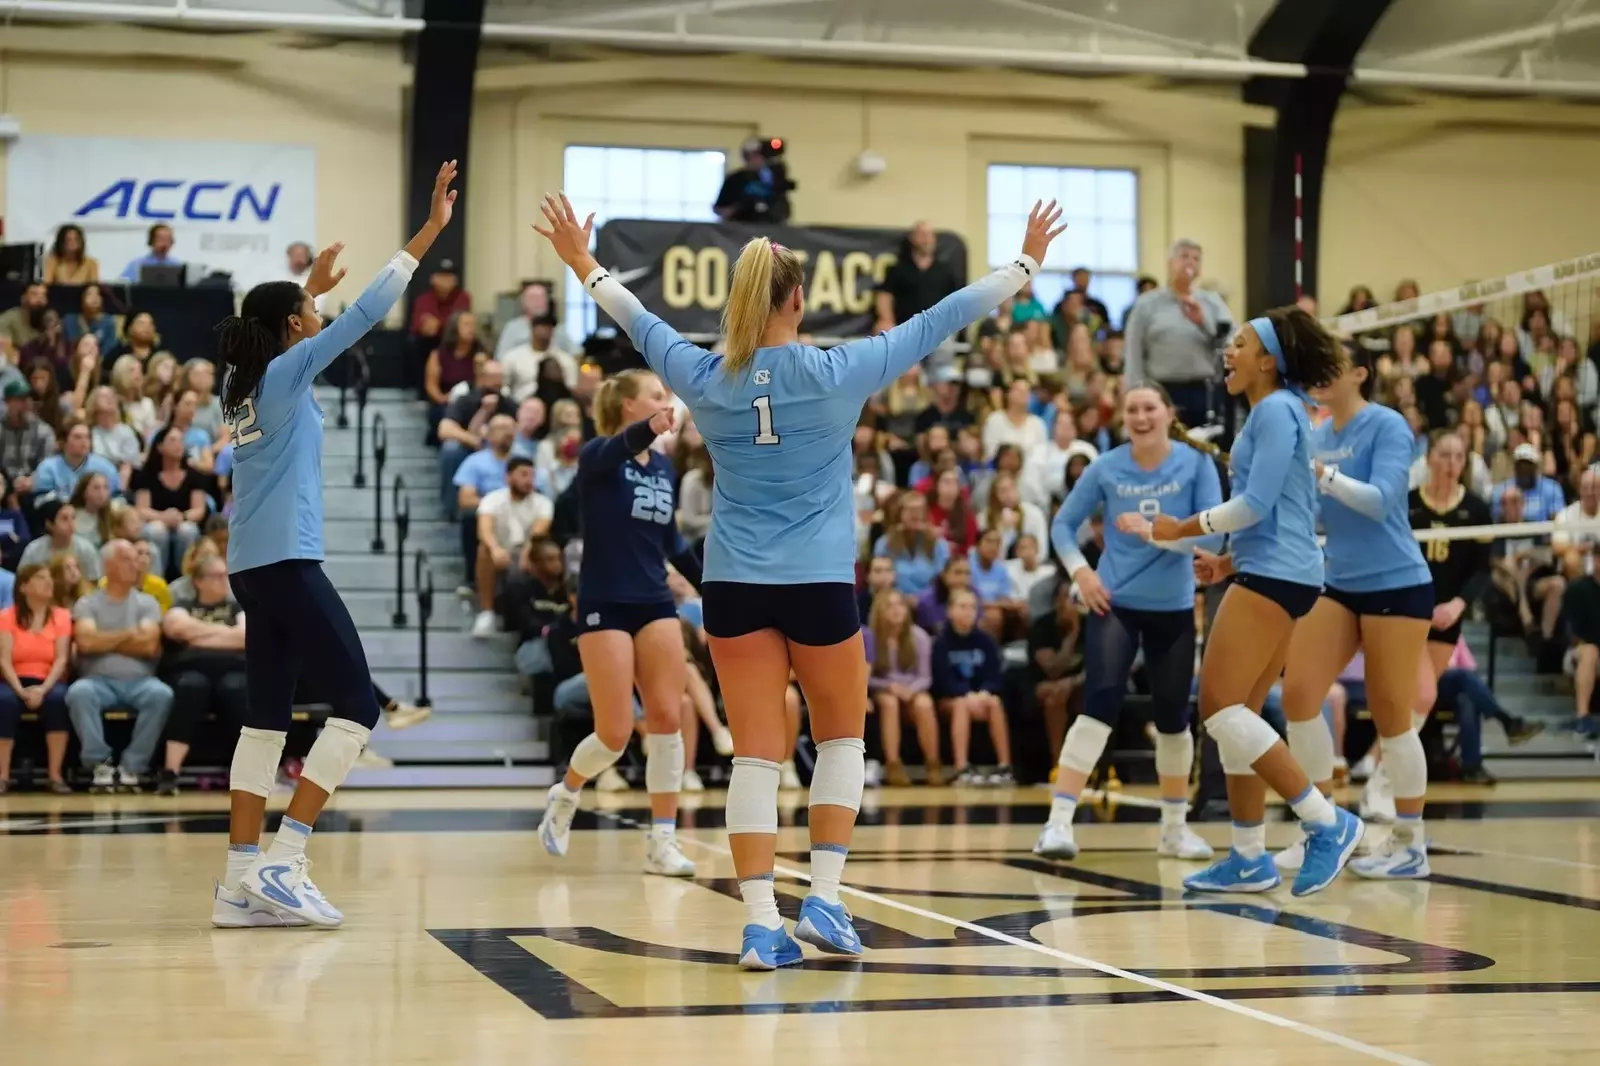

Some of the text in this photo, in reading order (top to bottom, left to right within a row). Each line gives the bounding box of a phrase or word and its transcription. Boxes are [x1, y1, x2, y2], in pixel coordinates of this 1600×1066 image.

[73, 179, 281, 222] ACCN
[663, 246, 729, 310] GO
[752, 395, 781, 445] 1
[631, 485, 673, 525] 25
